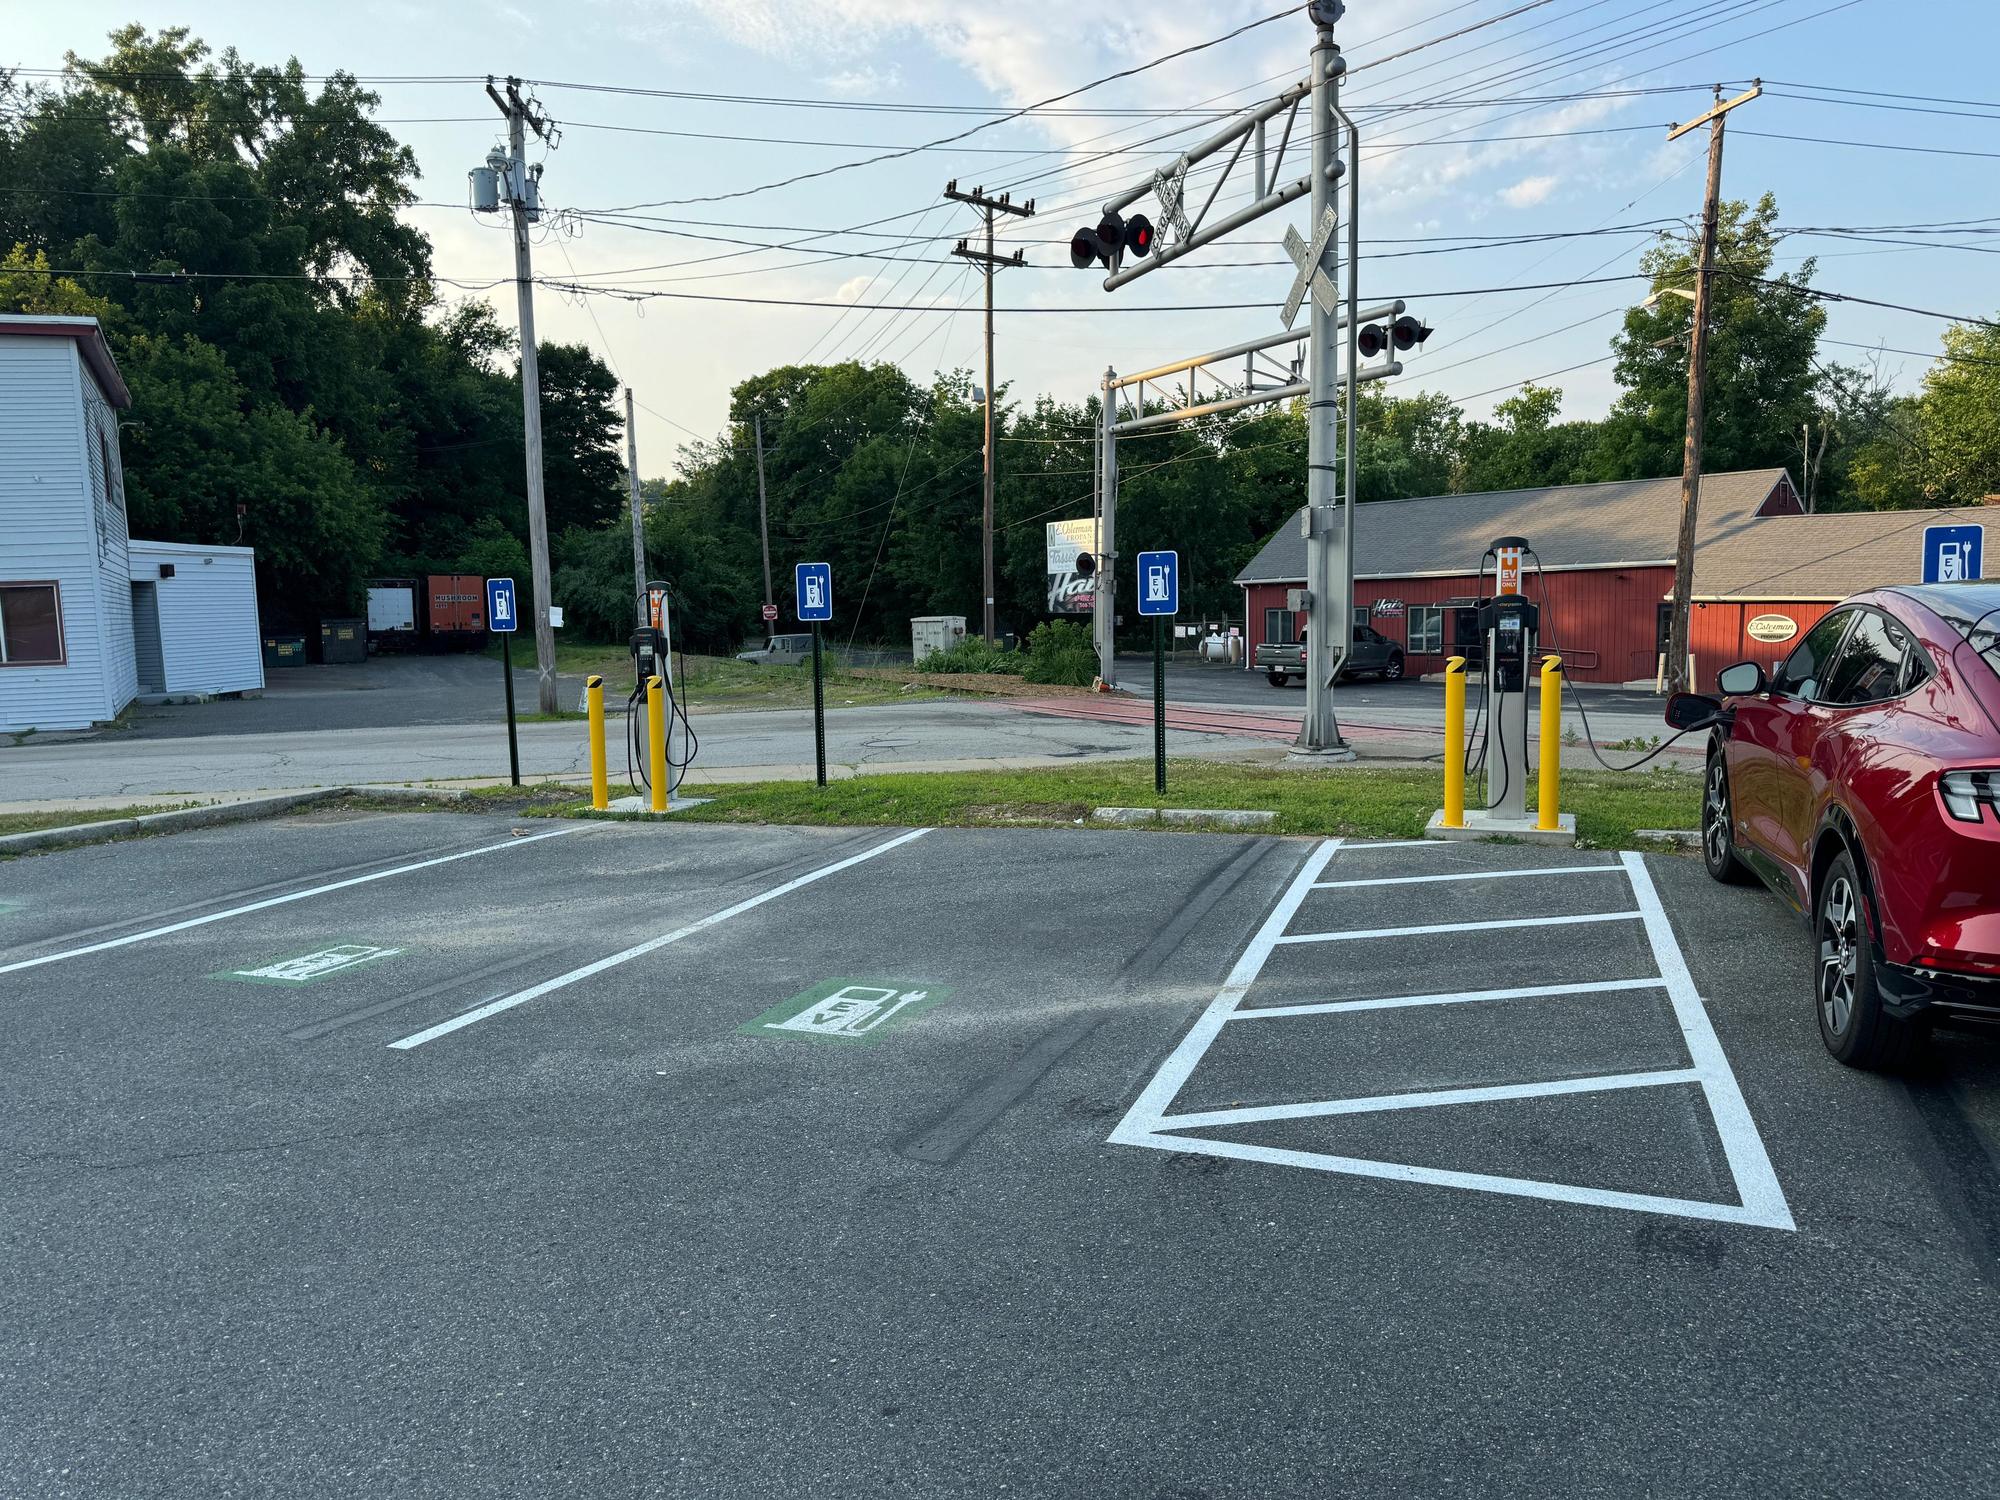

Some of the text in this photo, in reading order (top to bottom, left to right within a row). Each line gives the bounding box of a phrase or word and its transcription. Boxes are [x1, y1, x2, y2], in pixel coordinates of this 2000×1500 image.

[1503, 570, 1517, 579] EV
[1944, 558, 1953, 579] EV
[810, 588, 815, 603] EV
[1153, 578, 1159, 596] EV
[499, 601, 504, 616] EV
[1372, 598, 1404, 616] Hair
[812, 1001, 860, 1025] EV
